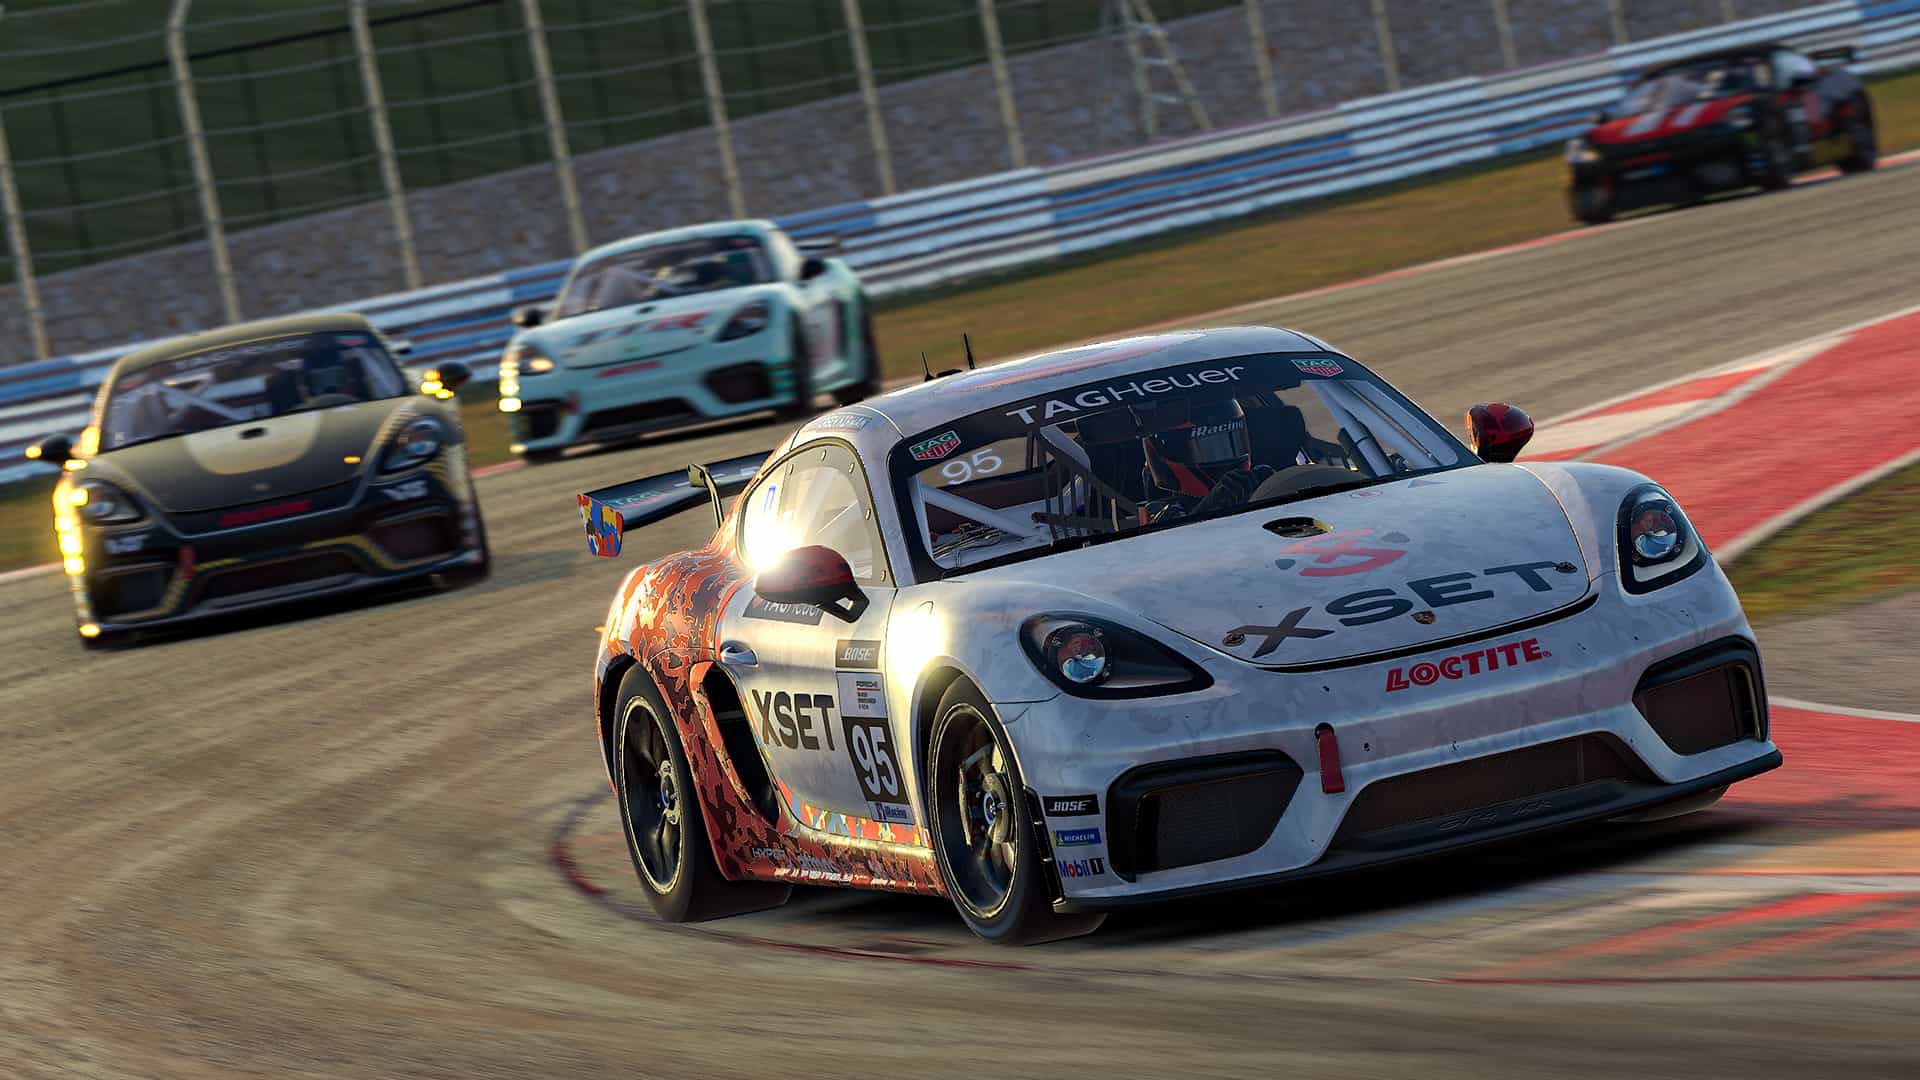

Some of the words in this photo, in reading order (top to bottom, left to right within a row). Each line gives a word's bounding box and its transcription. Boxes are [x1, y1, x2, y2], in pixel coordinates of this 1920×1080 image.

[916, 435, 954, 451] TAG
[942, 448, 1002, 485] 95
[1225, 561, 1558, 658] XSET
[840, 647, 875, 661] BOSE
[1386, 638, 1542, 692] LOCTITE
[752, 689, 835, 751] XSET
[852, 724, 899, 796] 95
[1049, 800, 1093, 812] BOSE
[1064, 833, 1096, 842] MICHELIN
[1058, 858, 1091, 878] Mobil
